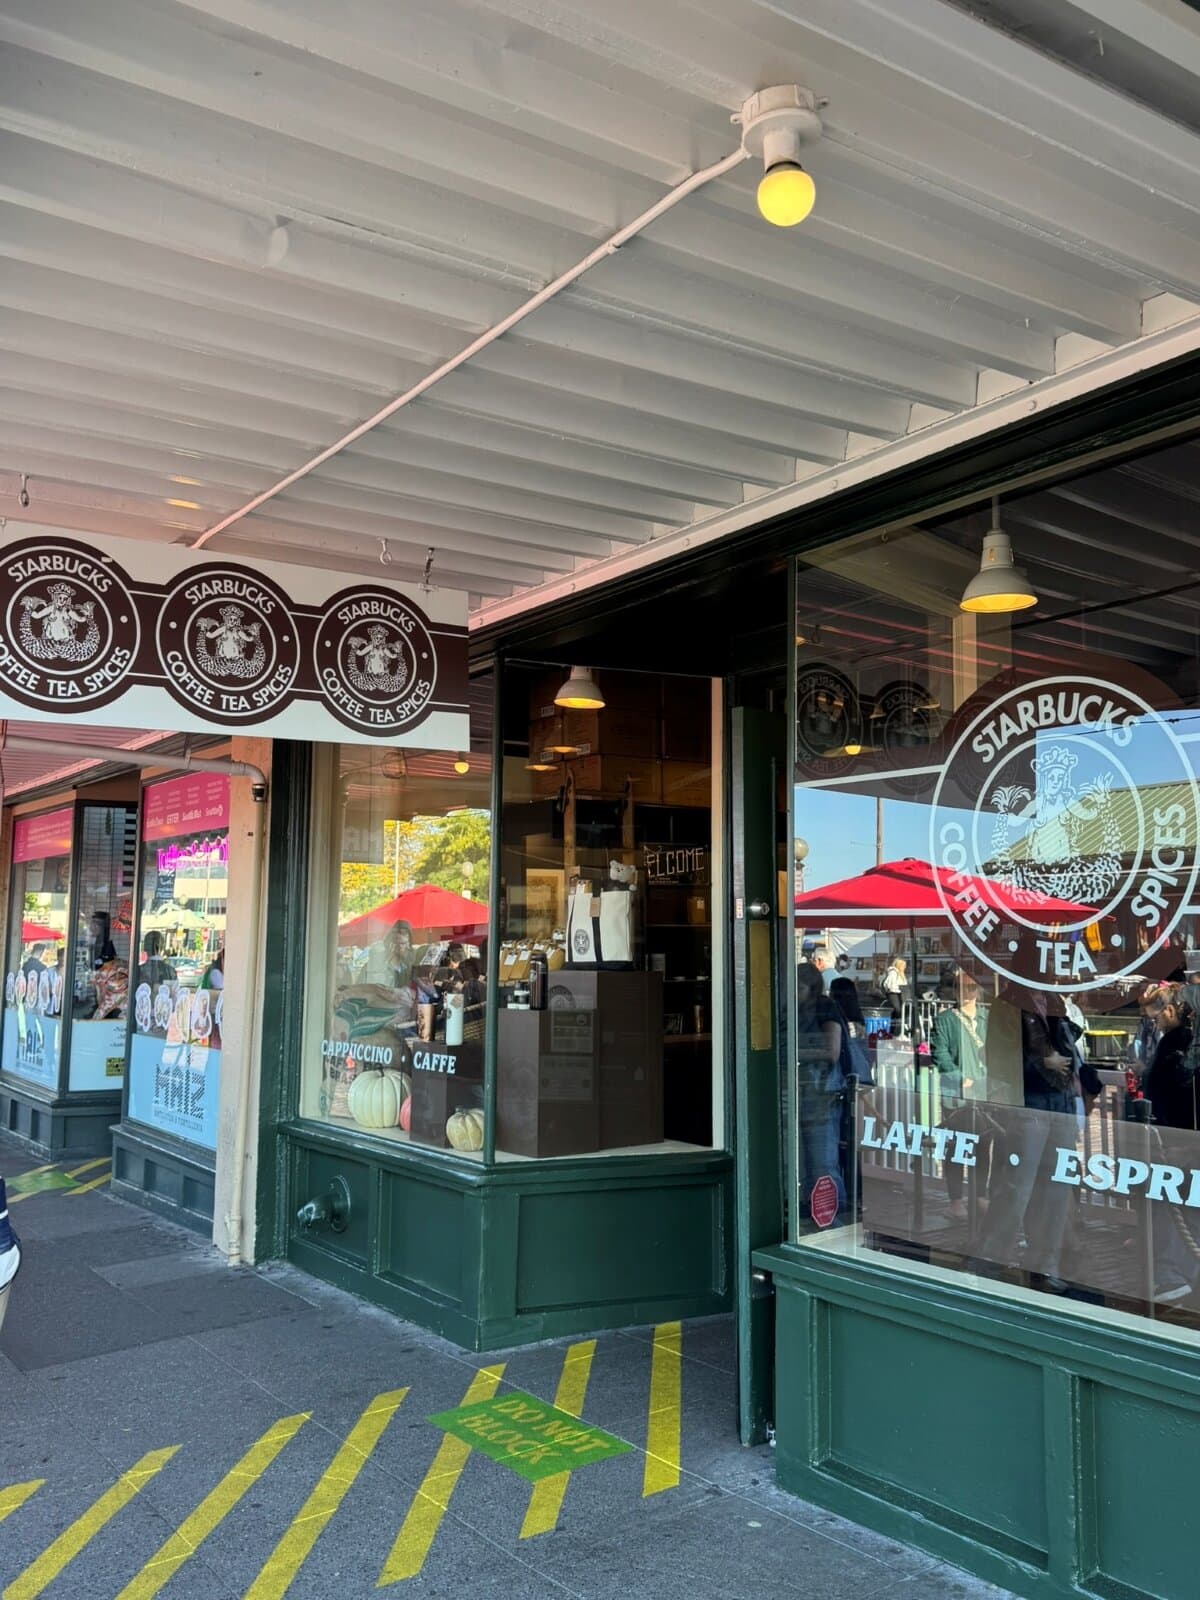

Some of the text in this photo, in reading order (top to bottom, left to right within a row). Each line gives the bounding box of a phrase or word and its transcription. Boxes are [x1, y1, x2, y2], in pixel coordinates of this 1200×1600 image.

[8, 555, 113, 593] STARBUCKS
[185, 579, 276, 614] STARBUCKS
[337, 601, 416, 633] STARBUCKS
[0, 637, 131, 697] OFFEE TEA SPICES
[167, 651, 292, 711] COFFEE TEA SPICES
[323, 668, 430, 723] COFFEE TEA SPICES
[972, 691, 1139, 763] STARBUCKS
[645, 846, 705, 878] ELCOME
[939, 803, 1187, 977] COFFEE TEA SPICES
[321, 1039, 457, 1075] CAPPUCCINO CAFFE
[860, 1116, 980, 1167] LATTE
[457, 1412, 563, 1465] BLOCK
[491, 1399, 610, 1453] DO NOT
